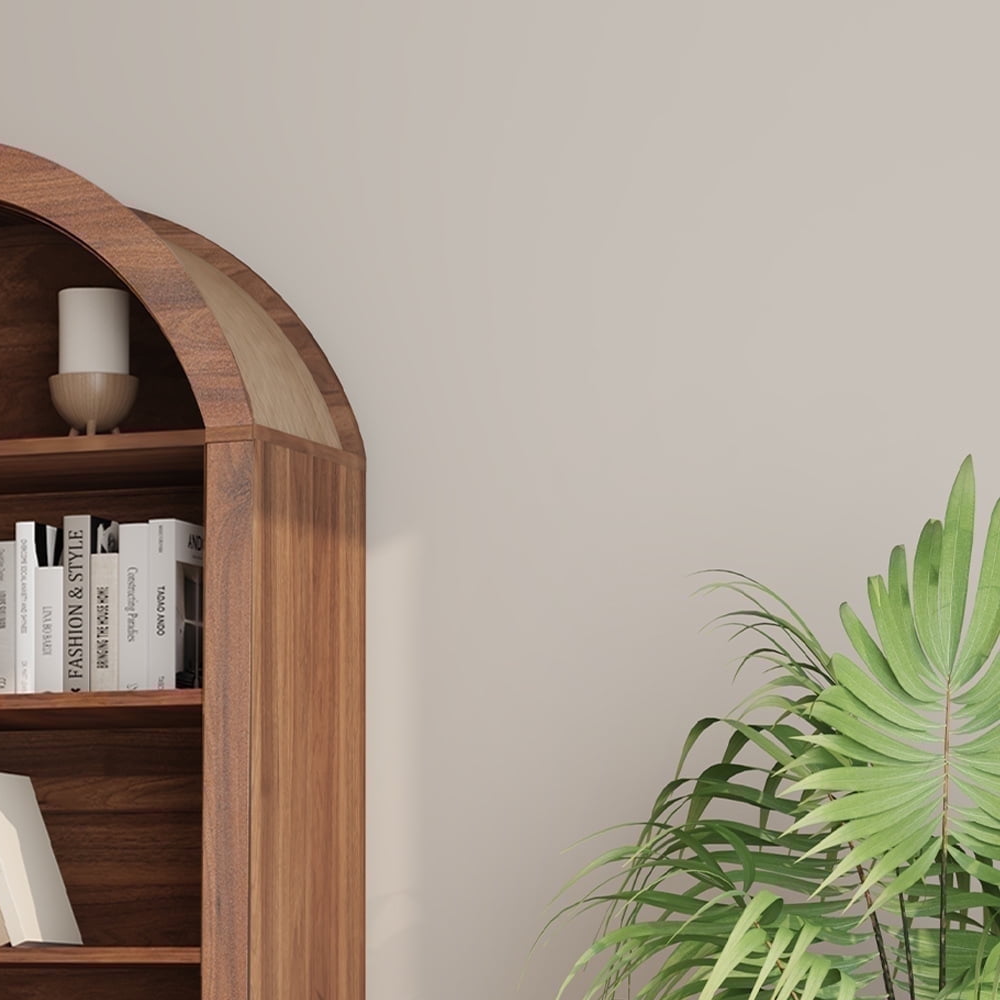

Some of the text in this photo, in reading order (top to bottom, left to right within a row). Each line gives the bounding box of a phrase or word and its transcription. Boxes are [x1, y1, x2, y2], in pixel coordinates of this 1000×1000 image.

[68, 529, 83, 679] FASHION & STYLE
[124, 566, 139, 611] Constructing
[156, 585, 166, 637] TADAO ANDO
[97, 626, 109, 638] THE
[97, 639, 109, 669] BRINGING
